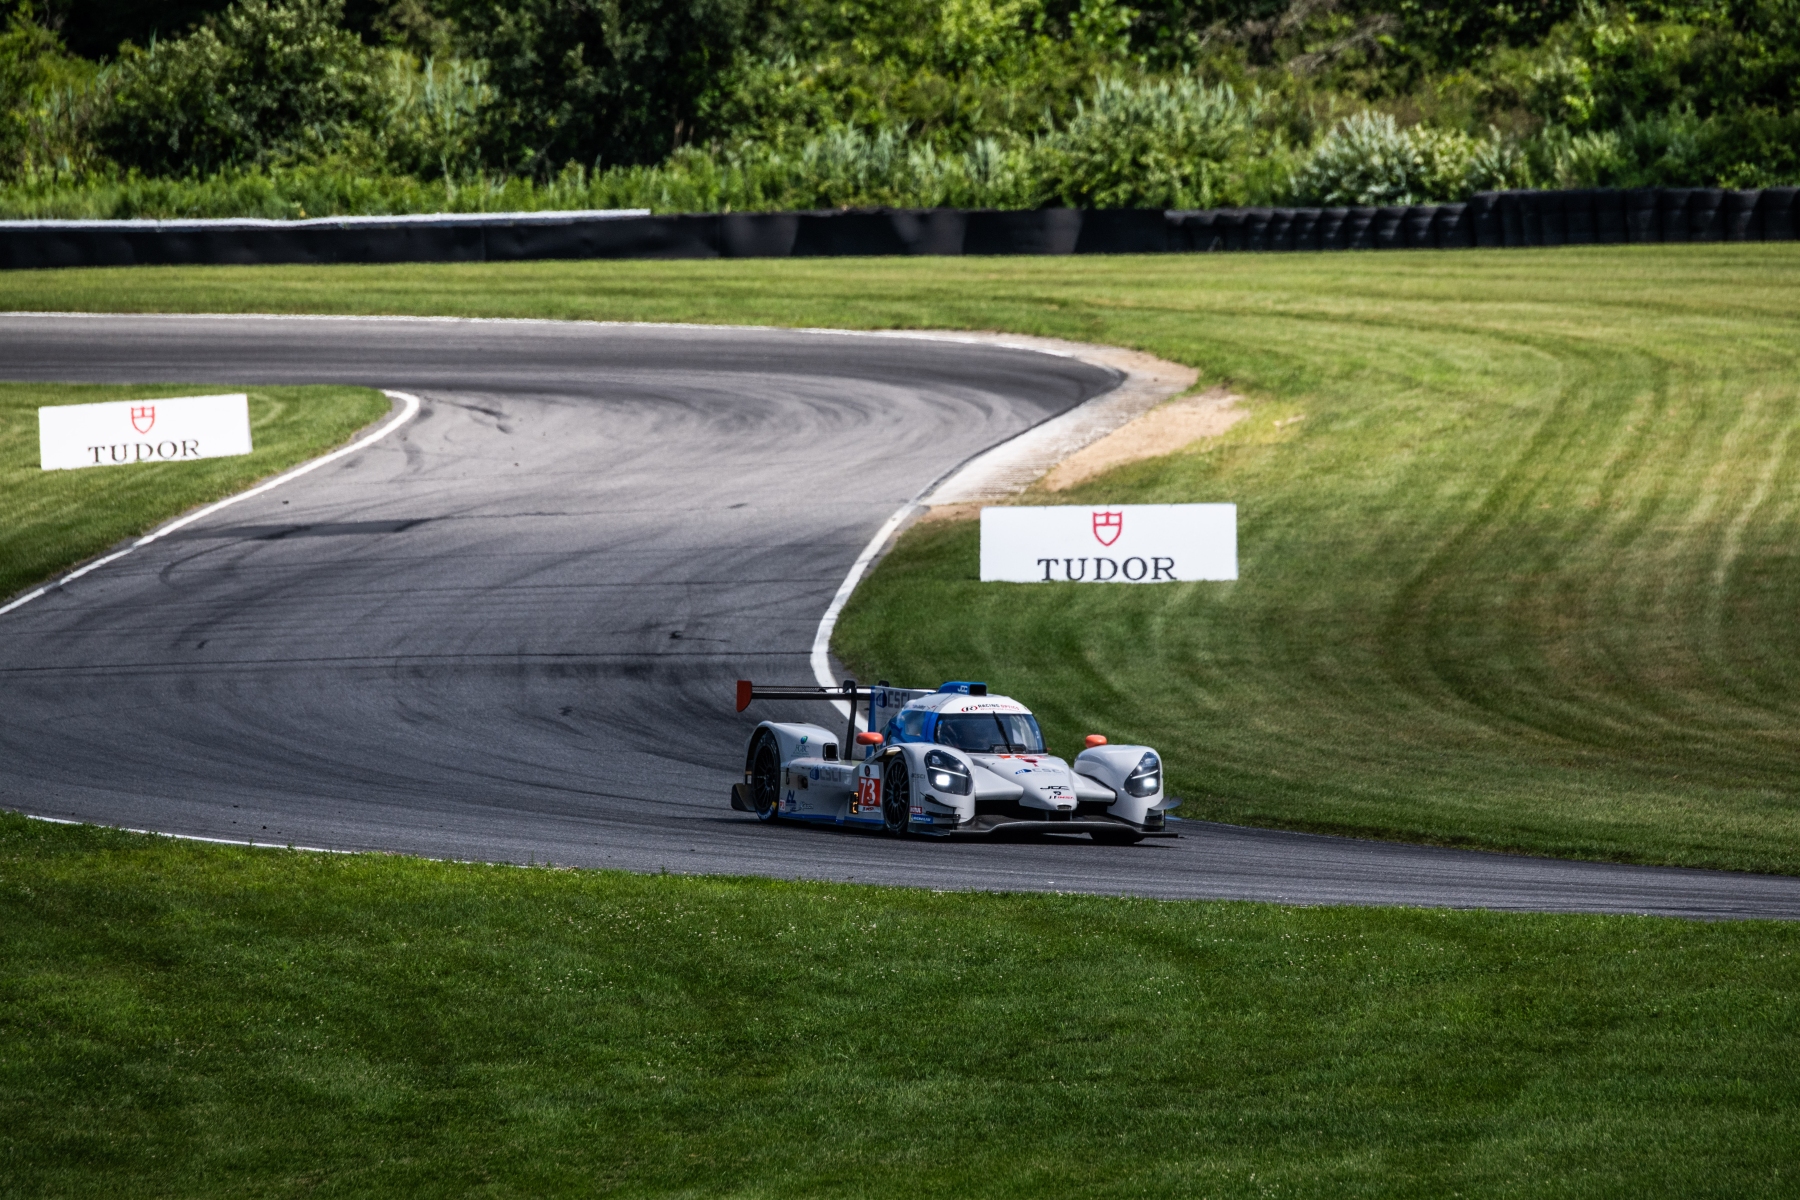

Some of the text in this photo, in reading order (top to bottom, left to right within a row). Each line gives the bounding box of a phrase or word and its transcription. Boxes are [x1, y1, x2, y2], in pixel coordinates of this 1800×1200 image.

[88, 439, 201, 464] TUDOR
[1037, 556, 1177, 581] TUDOR
[860, 778, 876, 805] 73
